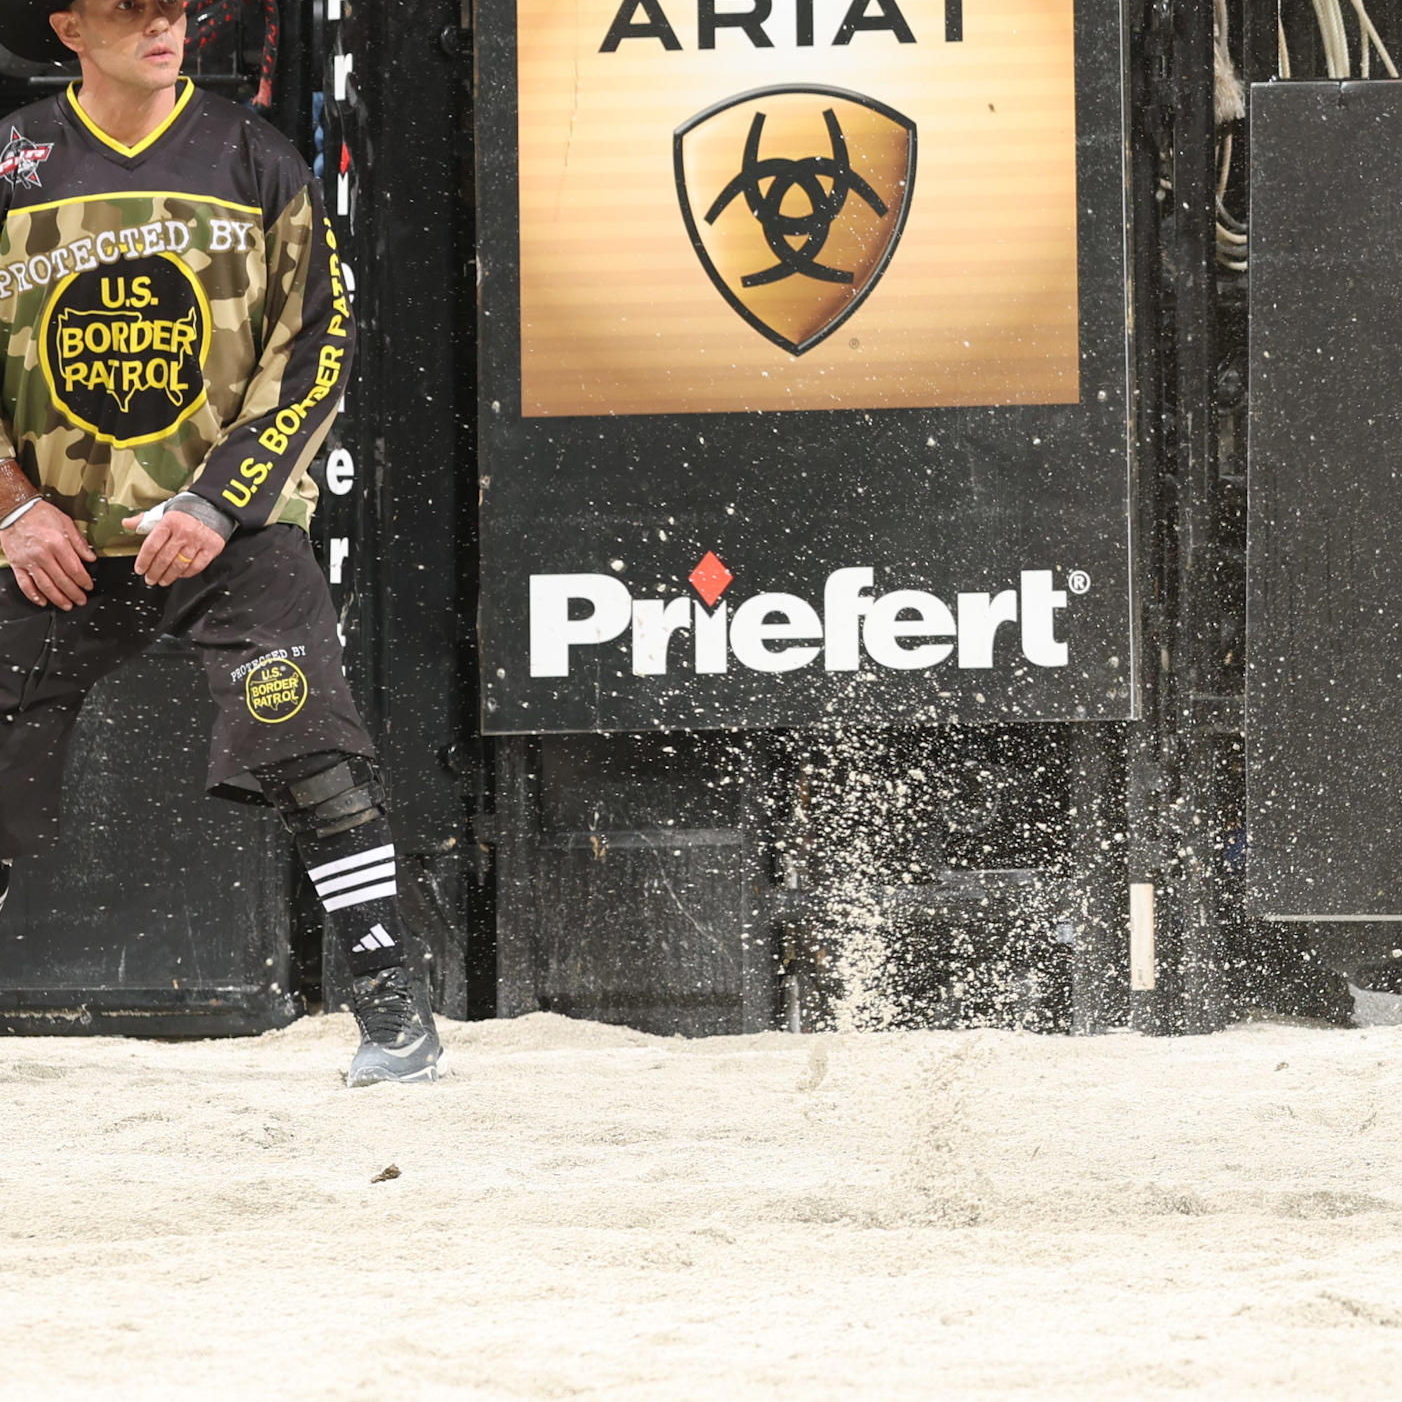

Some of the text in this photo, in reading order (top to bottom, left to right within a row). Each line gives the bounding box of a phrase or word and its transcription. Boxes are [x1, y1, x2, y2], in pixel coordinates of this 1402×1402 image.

[0, 219, 253, 297] PROTECTED BY
[101, 276, 158, 308] U.S.
[62, 320, 196, 358] BORDER
[65, 357, 188, 392] PATROL
[222, 457, 273, 508] U.S.
[291, 645, 306, 657] BY
[251, 678, 299, 698] BORDER
[253, 689, 299, 709] PATROL
